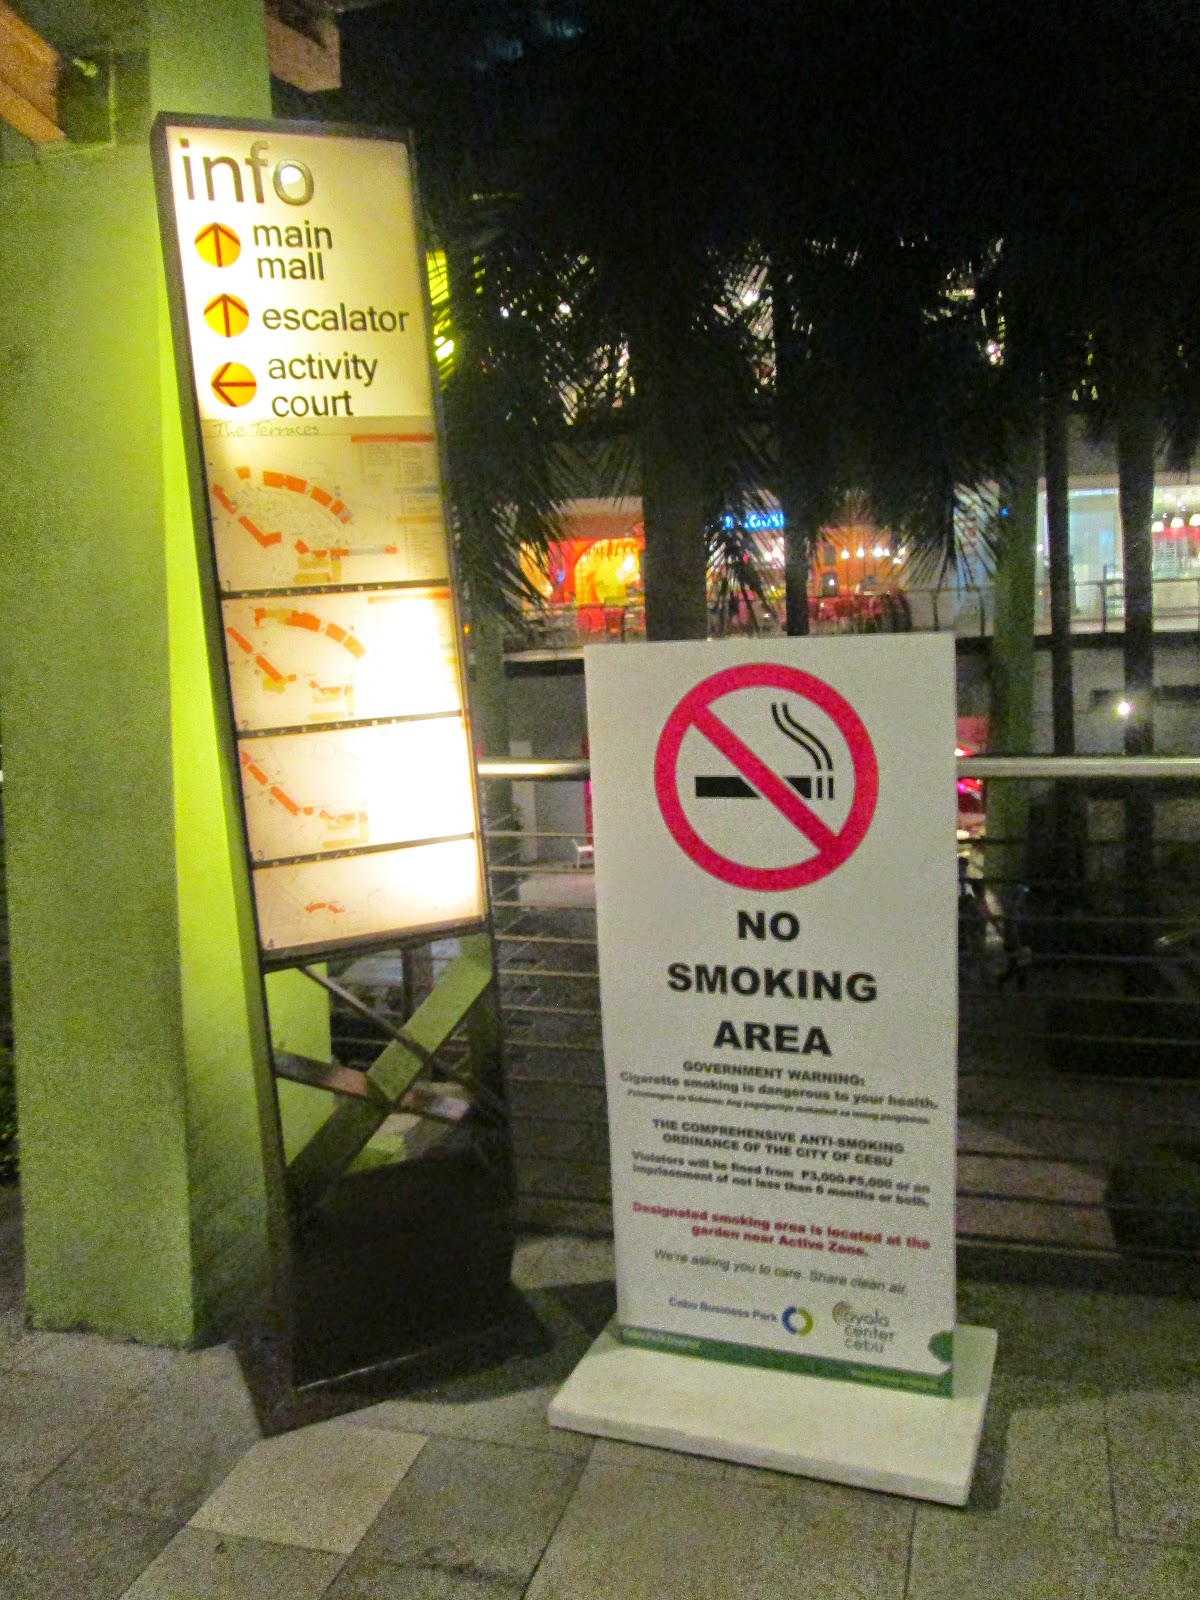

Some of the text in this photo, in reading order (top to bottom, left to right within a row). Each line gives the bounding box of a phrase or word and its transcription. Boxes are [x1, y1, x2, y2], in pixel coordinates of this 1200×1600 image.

[178, 137, 315, 206] info
[253, 220, 332, 250] main
[256, 252, 325, 281] mall
[262, 302, 409, 332] escalator
[267, 351, 378, 387] activity
[271, 390, 354, 418] court
[213, 420, 319, 437] The Terraces
[737, 909, 800, 942] NO
[667, 962, 878, 1004] SMOKING
[713, 1020, 832, 1057] AREA
[620, 1071, 680, 1086] Cigarette
[683, 1078, 740, 1095] smoking
[742, 1082, 755, 1094] is
[758, 1083, 831, 1100] dangerous
[833, 1090, 850, 1102] to
[852, 1092, 885, 1106] your
[682, 1060, 866, 1087] GOVERNMENT WARNING:
[651, 1118, 905, 1155] THE COMPREHENSIVE ANTI-SMOKING
[662, 1132, 894, 1168] ORDINANCE OF THE CITY OF CEBU
[631, 1150, 685, 1167] Violators
[687, 1157, 711, 1169] will
[712, 1159, 729, 1172] be
[731, 1161, 763, 1176] fined
[765, 1165, 795, 1178] from
[896, 1180, 911, 1192] or
[715, 1173, 729, 1184] of
[732, 1175, 753, 1187] not
[755, 1176, 781, 1191] less
[784, 1180, 813, 1194] than
[815, 1184, 825, 1196] 6
[827, 1186, 876, 1202] months
[878, 1192, 893, 1204] or
[632, 1200, 931, 1250] Designated smoking area is located at the
[691, 1224, 740, 1242] garden
[743, 1231, 775, 1245] near
[778, 1234, 825, 1251] Active
[654, 1248, 688, 1265] We're
[690, 1255, 731, 1273] asking
[733, 1261, 757, 1274] you
[759, 1263, 772, 1276] to
[809, 1268, 848, 1287] Share
[850, 1276, 886, 1292] clean
[700, 1301, 750, 1319] Business
[751, 1308, 779, 1323] Park
